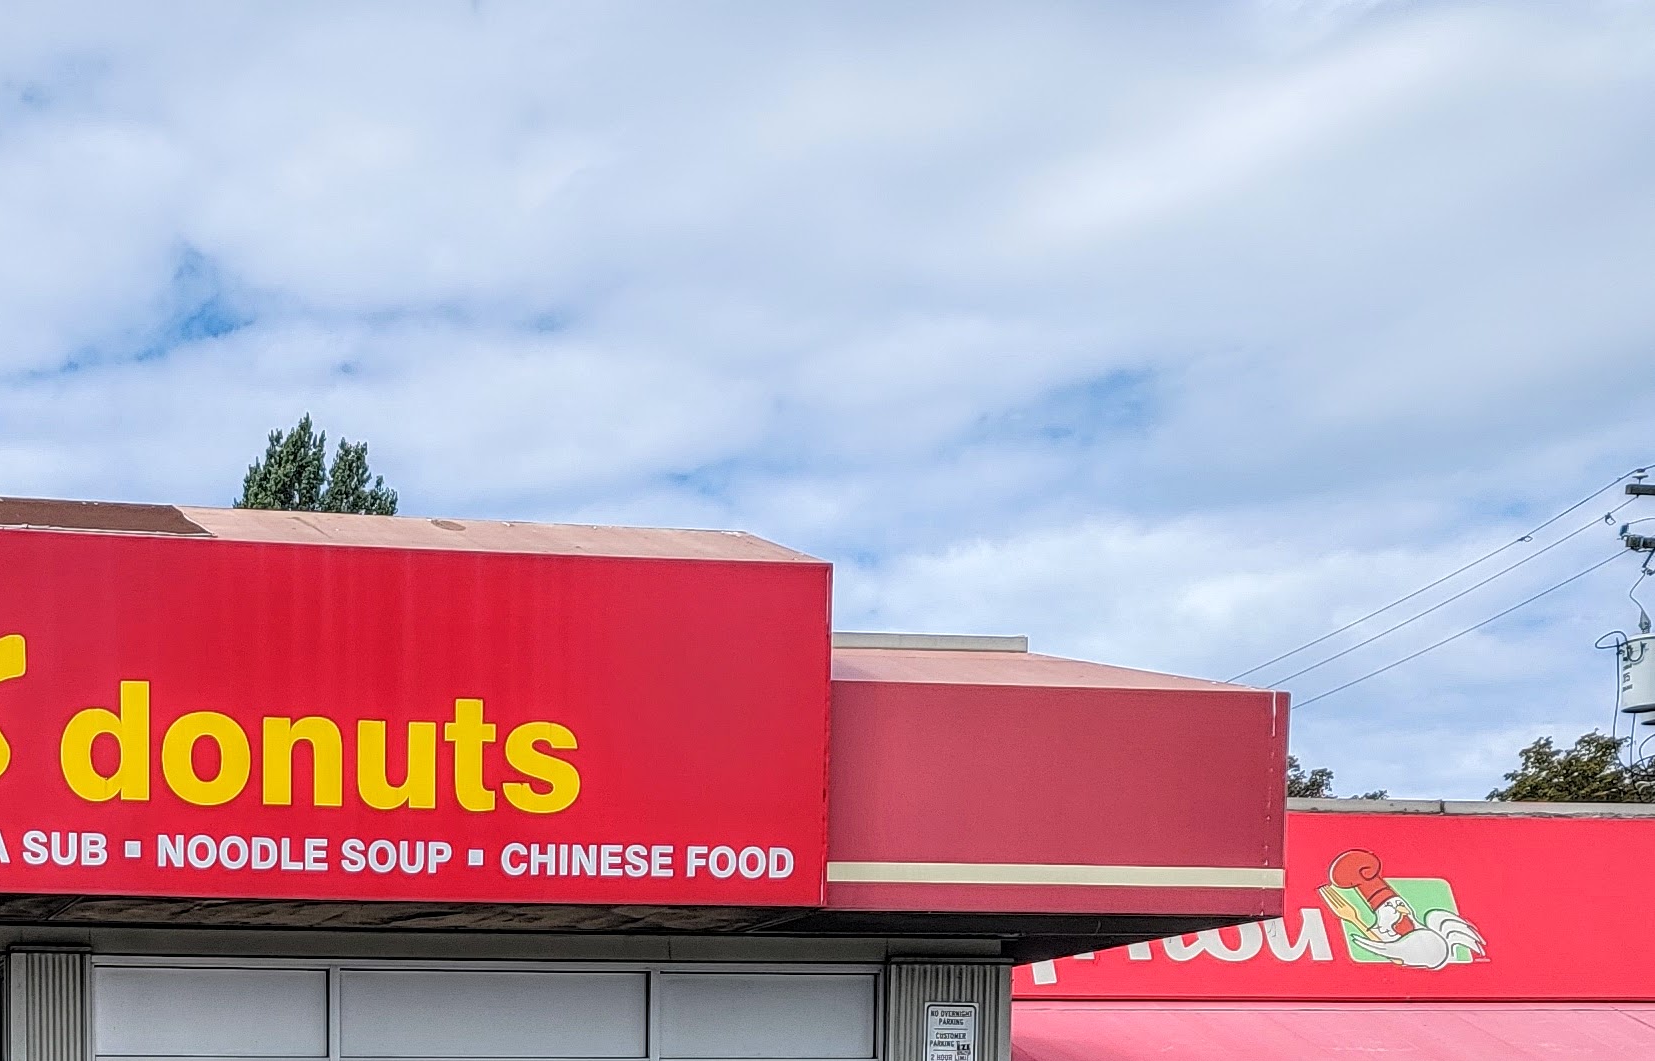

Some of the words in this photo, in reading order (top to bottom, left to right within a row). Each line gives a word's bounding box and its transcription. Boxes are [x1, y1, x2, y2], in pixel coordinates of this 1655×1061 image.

[60, 681, 581, 814] donuts
[22, 831, 108, 867] SUB
[157, 834, 329, 871] NOODLE
[341, 837, 452, 874] SOUP
[501, 843, 674, 877] CHINESE
[686, 846, 794, 879] FOOD
[938, 1018, 964, 1026] PARKING
[935, 1032, 967, 1040] CUSTOMER
[930, 1040, 955, 1048] PARKING
